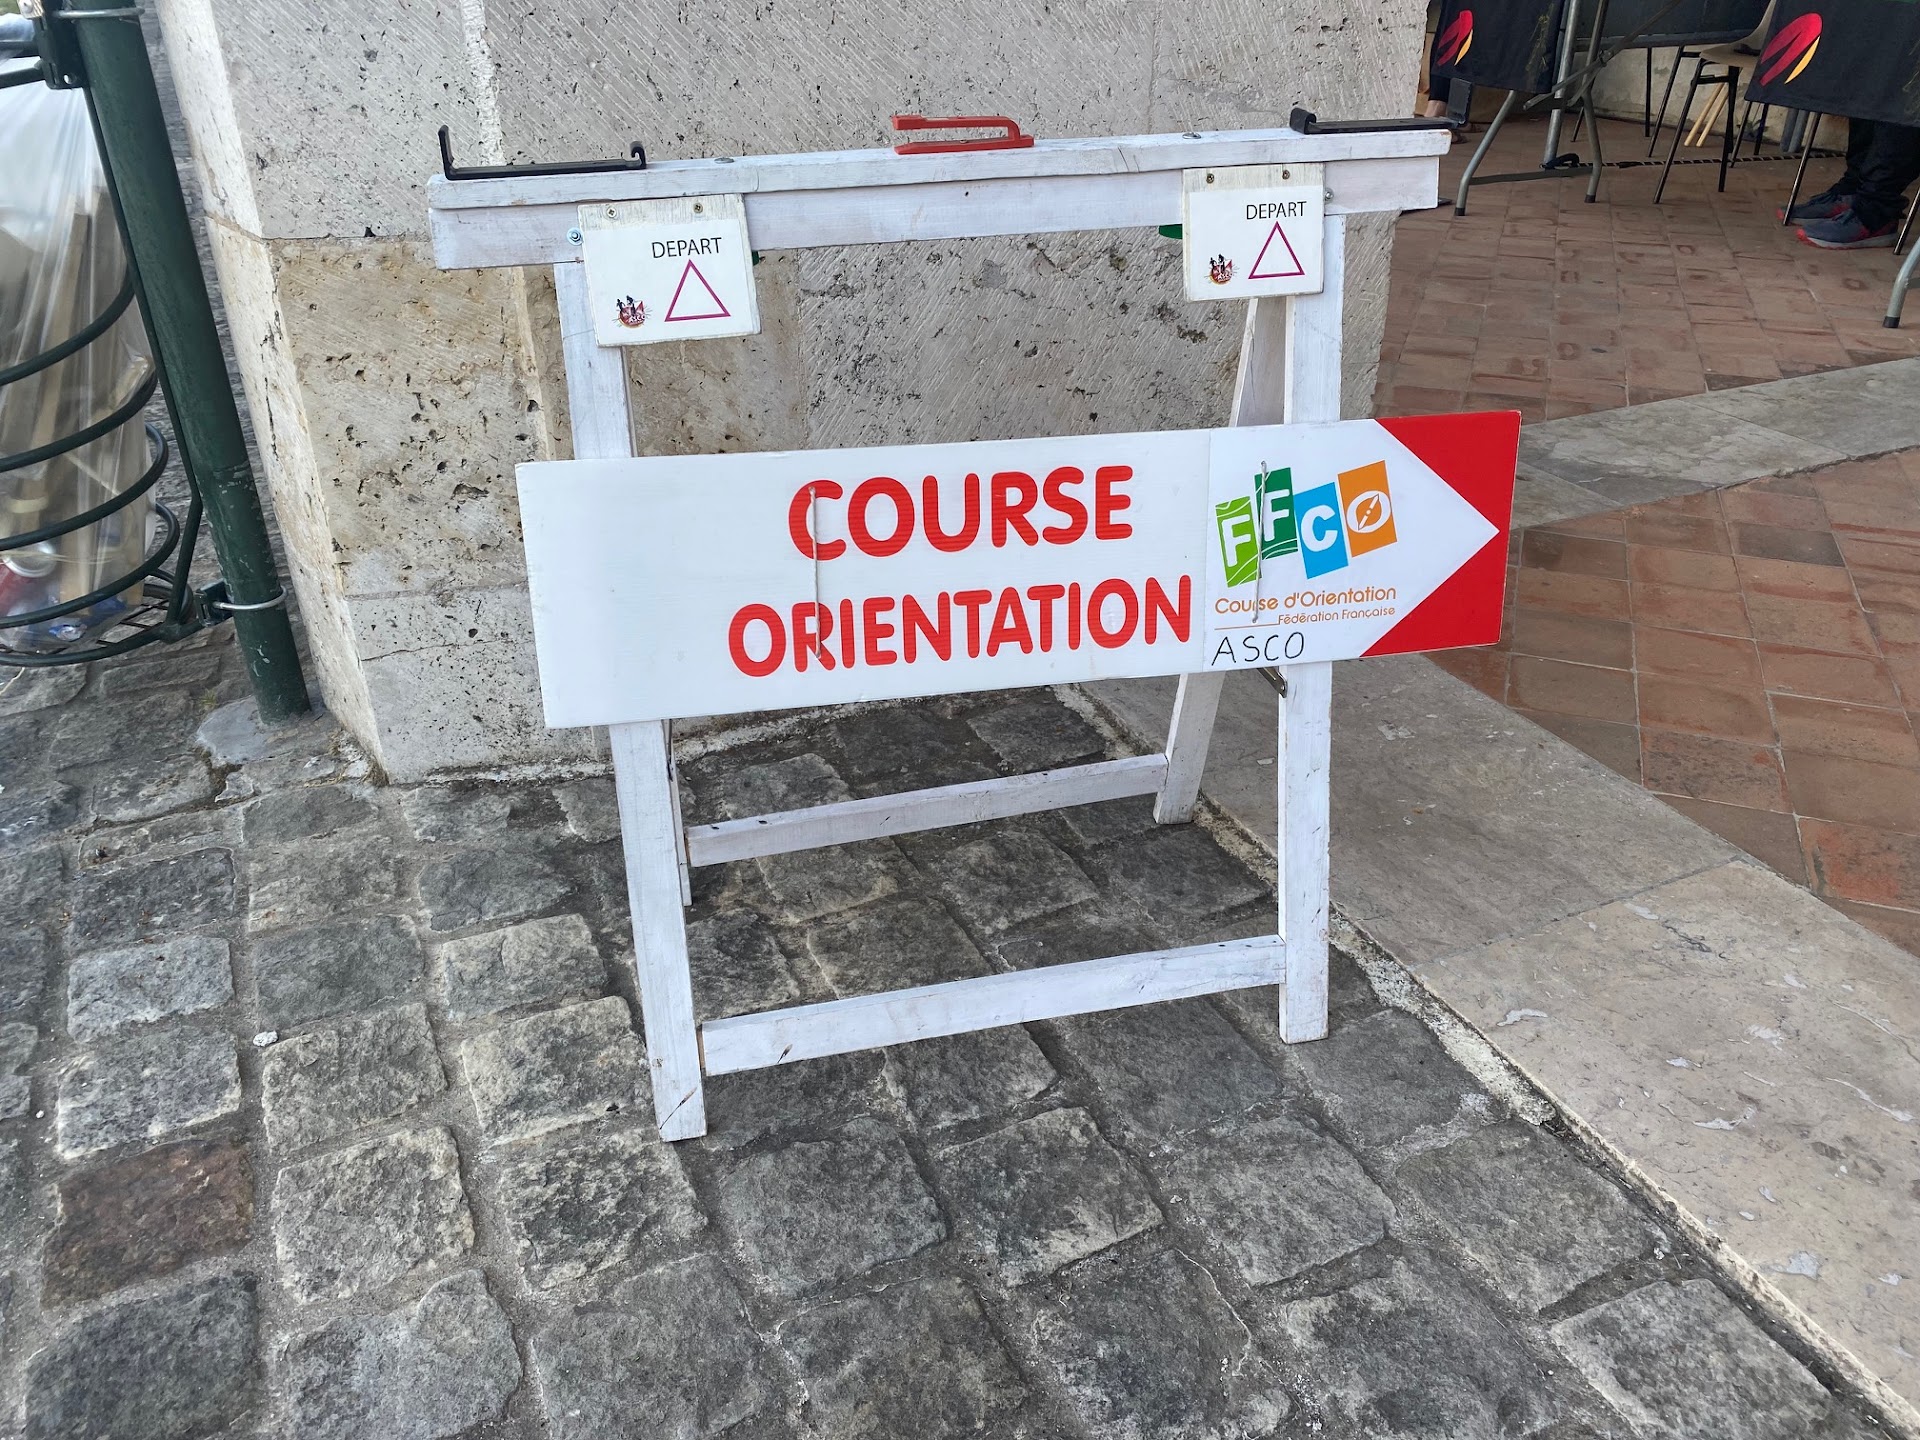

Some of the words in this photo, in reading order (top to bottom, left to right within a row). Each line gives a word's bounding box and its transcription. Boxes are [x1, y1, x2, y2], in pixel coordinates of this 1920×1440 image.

[1246, 201, 1307, 220] DEPART
[651, 237, 722, 259] DEPART
[788, 465, 1134, 561] COURSE
[1221, 488, 1392, 568] FFCO
[1284, 586, 1397, 609] d'Orientation
[727, 574, 1192, 677] ORIENTATION
[1278, 610, 1339, 625] Fédération
[1342, 606, 1396, 620] Française
[1211, 631, 1305, 667] ASCO
